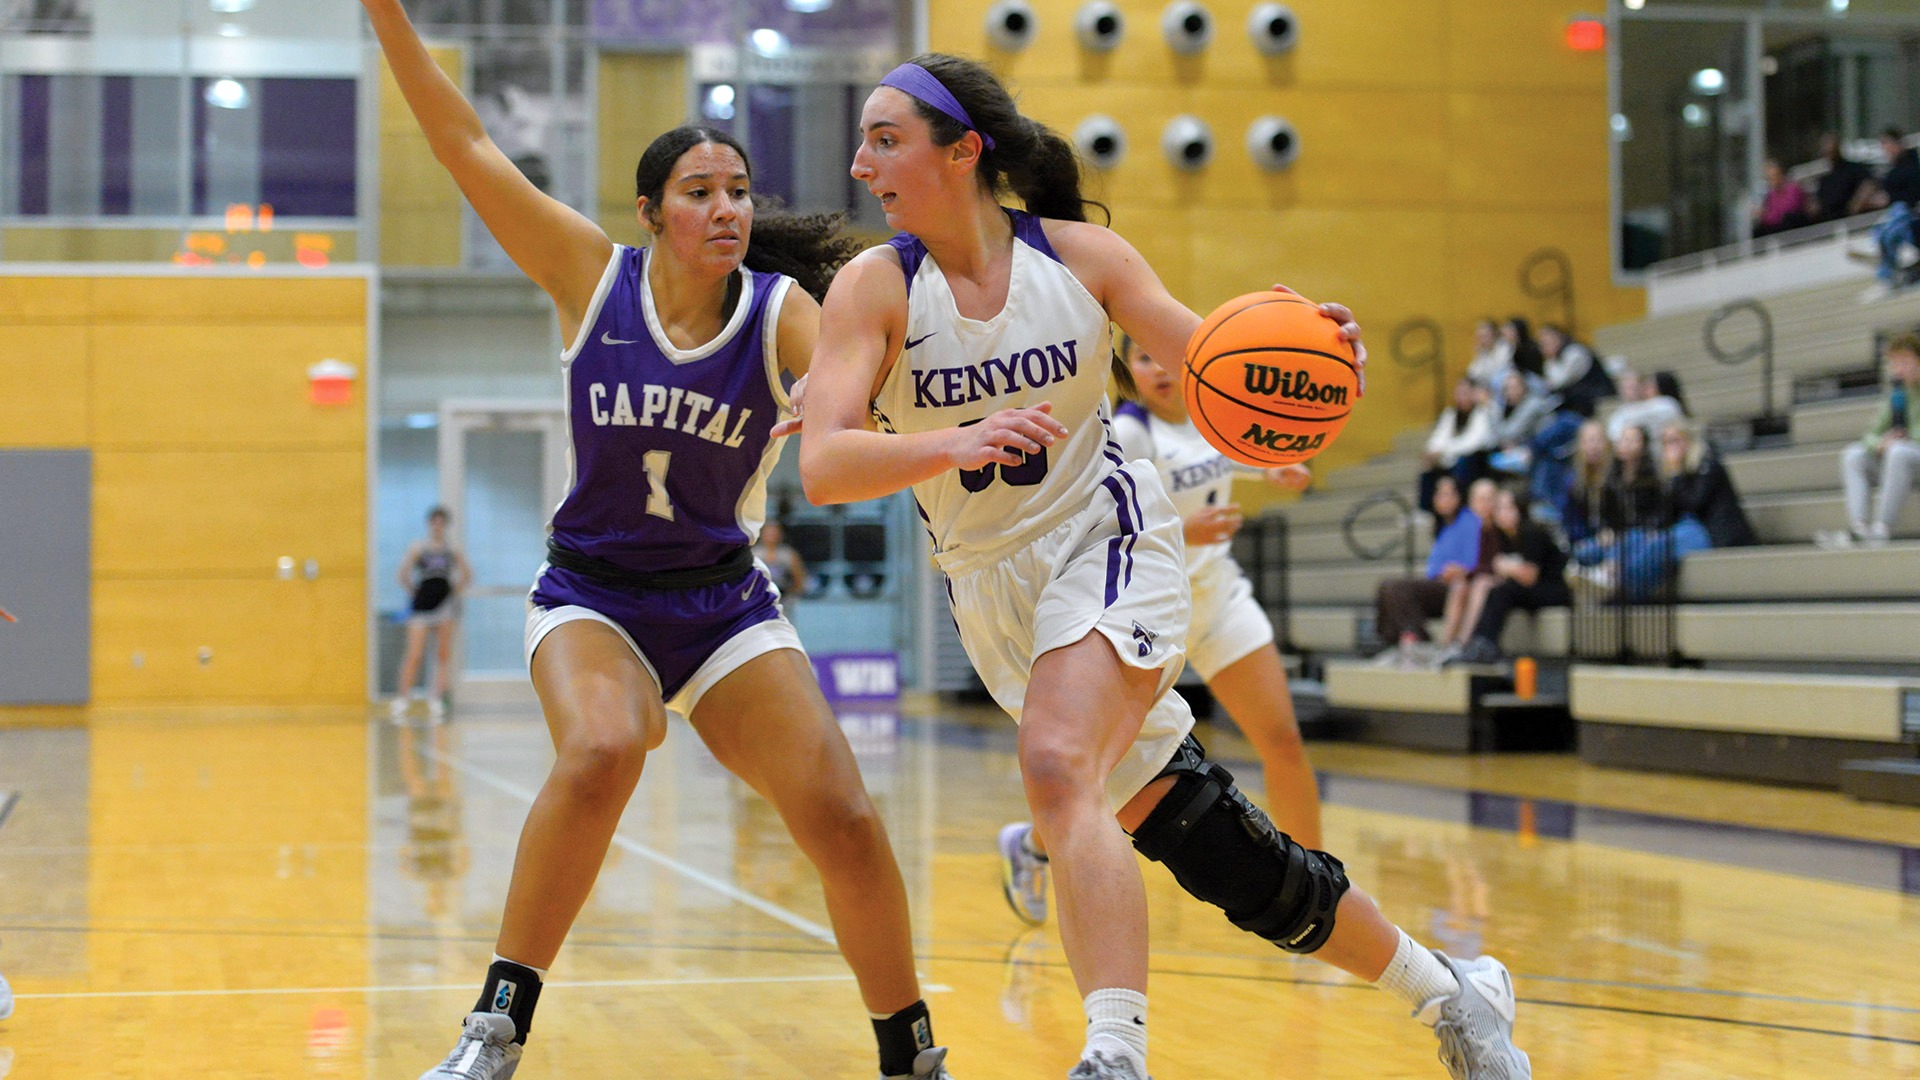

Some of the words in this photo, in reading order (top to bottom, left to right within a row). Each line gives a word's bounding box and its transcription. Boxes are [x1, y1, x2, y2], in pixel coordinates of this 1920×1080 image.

[911, 339, 1078, 409] KENYON
[1244, 362, 1348, 406] Wilson
[588, 382, 753, 449] CAPITAL
[1240, 422, 1327, 453] NCAA
[642, 449, 675, 522] 1
